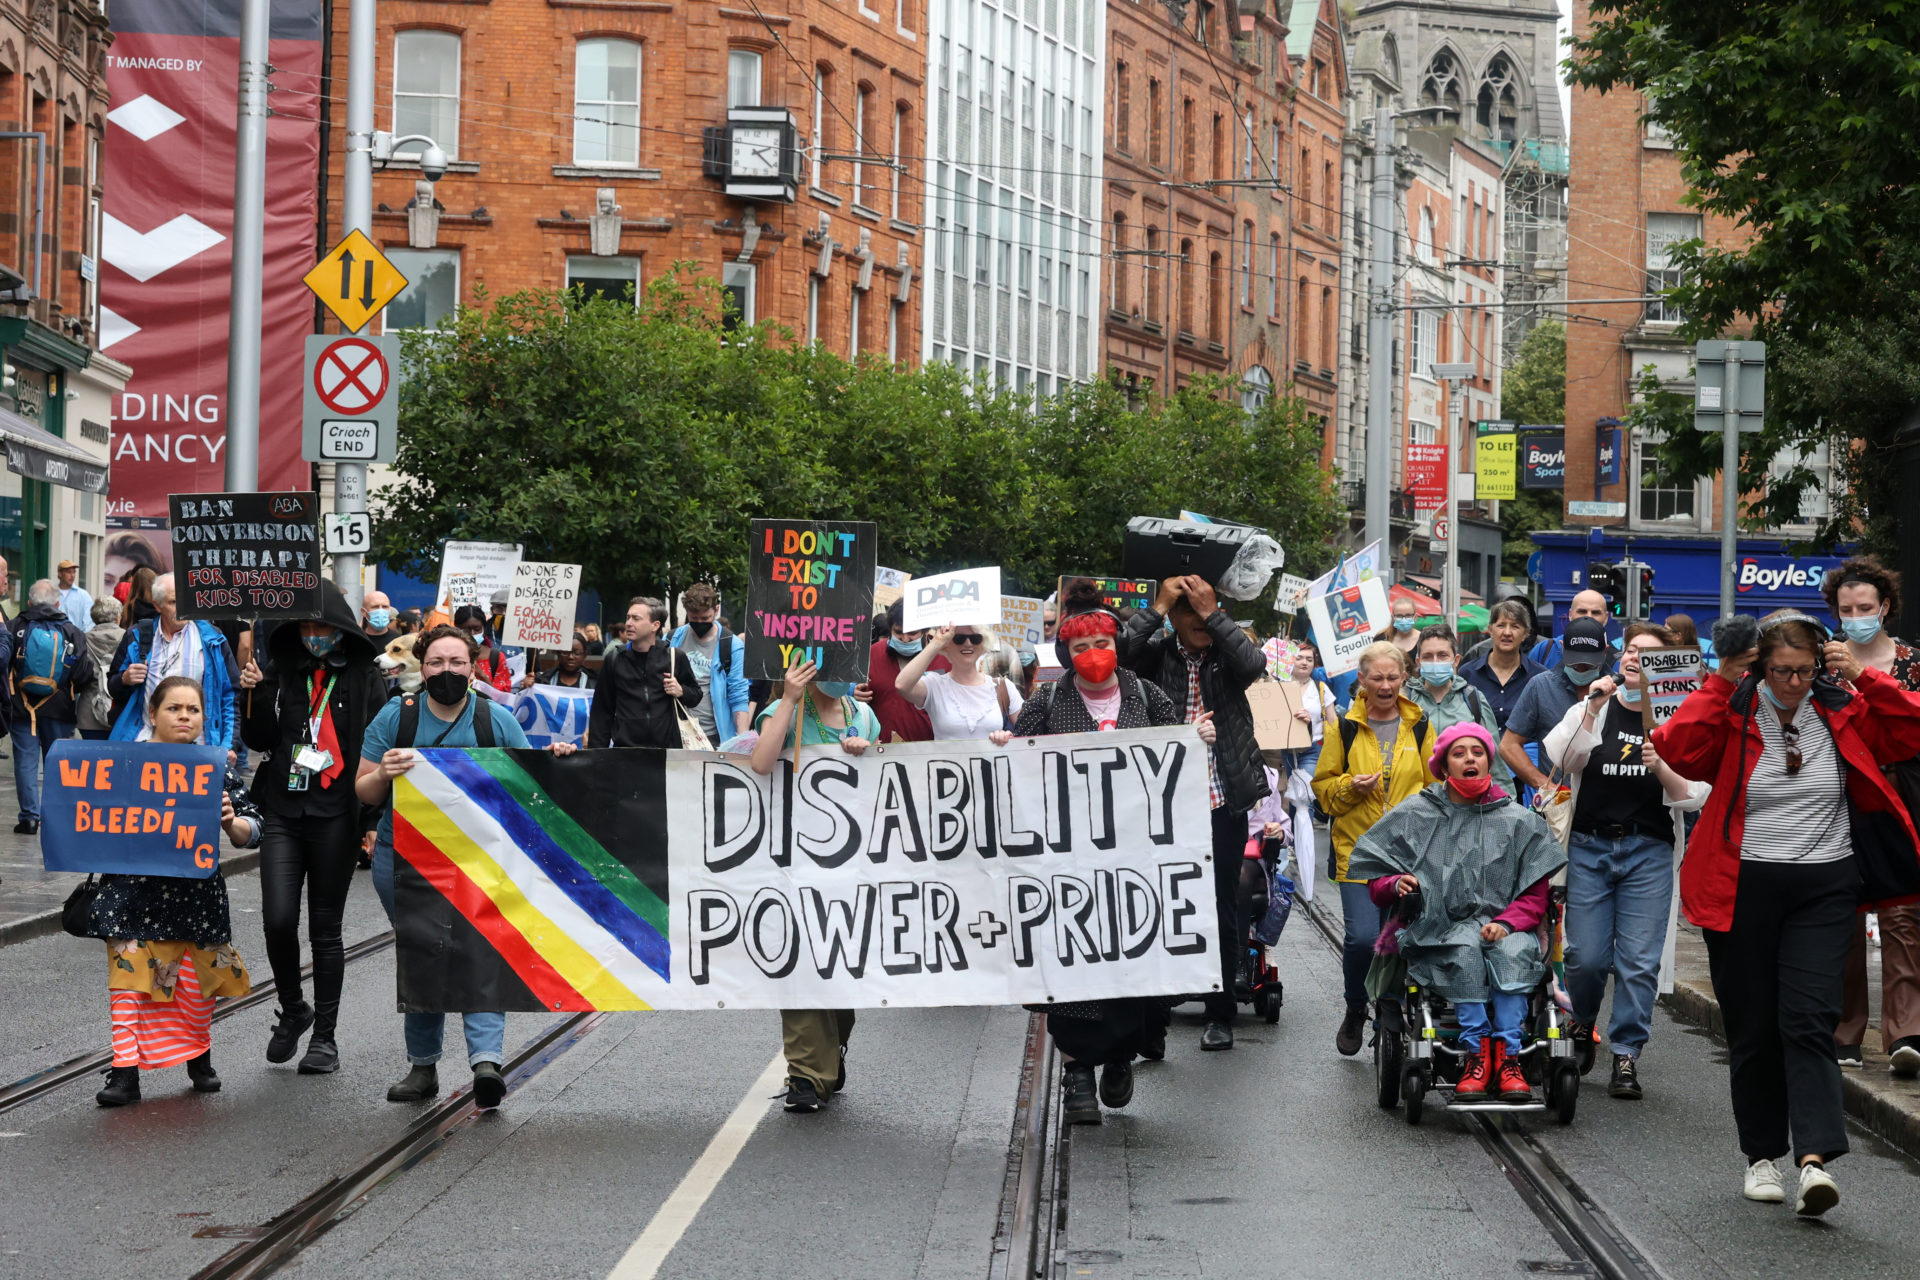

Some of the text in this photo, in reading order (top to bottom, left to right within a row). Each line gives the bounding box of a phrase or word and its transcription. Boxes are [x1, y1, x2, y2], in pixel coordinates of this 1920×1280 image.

[117, 57, 183, 70] MANAGED
[187, 59, 203, 71] BY
[110, 393, 219, 423] DING
[329, 426, 370, 438] Crioch
[110, 432, 226, 463] ANCY
[335, 441, 364, 451] END
[1480, 442, 1514, 451] TO LET
[1600, 445, 1613, 463] Boyle
[1535, 467, 1565, 478] Sport
[180, 500, 234, 518] BAN
[274, 498, 302, 512] ABA
[172, 523, 316, 543] CONVERSION
[333, 522, 364, 546] 15
[764, 528, 856, 557] I DON'T
[188, 549, 310, 569] THERAPY
[188, 568, 318, 589] FOR DISABLED
[516, 565, 573, 579] NO-ONE IS
[772, 556, 842, 588] EXIST
[534, 578, 556, 588] TOO
[1091, 580, 1147, 593] THING
[196, 588, 294, 608] KIDS TOO
[515, 587, 573, 599] DISABLED
[789, 585, 818, 610] TO
[917, 579, 979, 607] DADA
[533, 599, 554, 608] FOR
[1001, 598, 1038, 612] BLED
[1130, 598, 1148, 609] US
[514, 606, 556, 619] EQUAL
[1004, 610, 1032, 623] PLE
[518, 618, 561, 631] HUMAN
[754, 610, 866, 641] "INSPIRE"
[992, 624, 1026, 635] AN'T
[518, 629, 562, 644] RIGHTS
[1570, 637, 1599, 648] GUINNESS
[779, 644, 824, 670] YOU
[1641, 654, 1699, 668] DISABLED
[1650, 679, 1697, 695] TRANS
[1618, 731, 1643, 745] PISS
[59, 759, 214, 795] WE ARE
[1602, 764, 1647, 776] ON PITY
[703, 741, 1186, 872] DISABILITY
